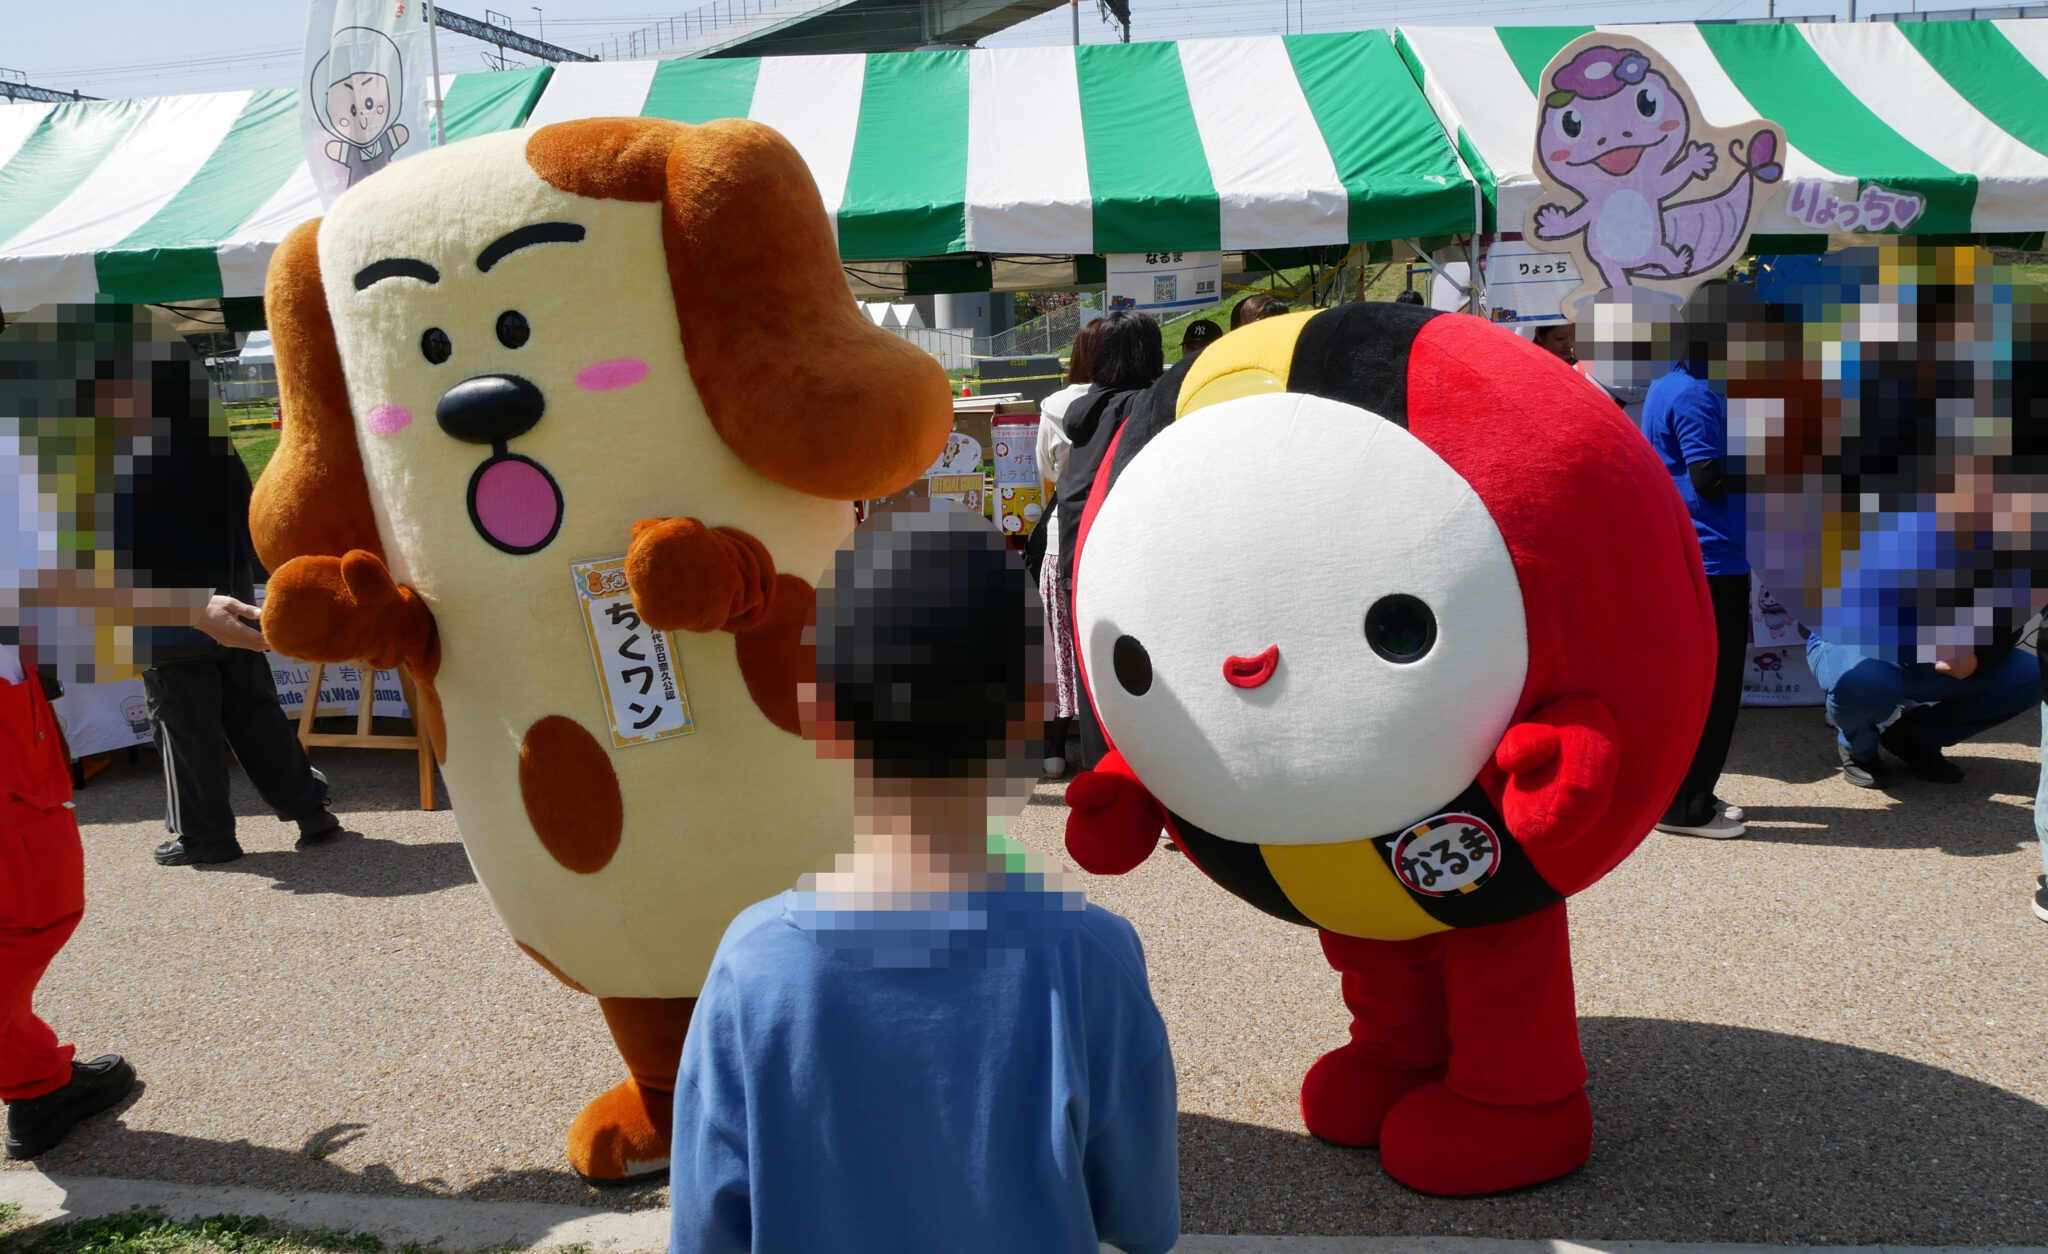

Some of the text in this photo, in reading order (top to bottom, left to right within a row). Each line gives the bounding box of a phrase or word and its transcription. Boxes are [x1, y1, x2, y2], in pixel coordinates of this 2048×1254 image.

[1791, 181, 1895, 228] りょっち
[1145, 251, 1184, 265] なるま
[1519, 260, 1567, 276] りょっち
[604, 601, 663, 730] ちくワン
[1399, 826, 1495, 888] なるま
